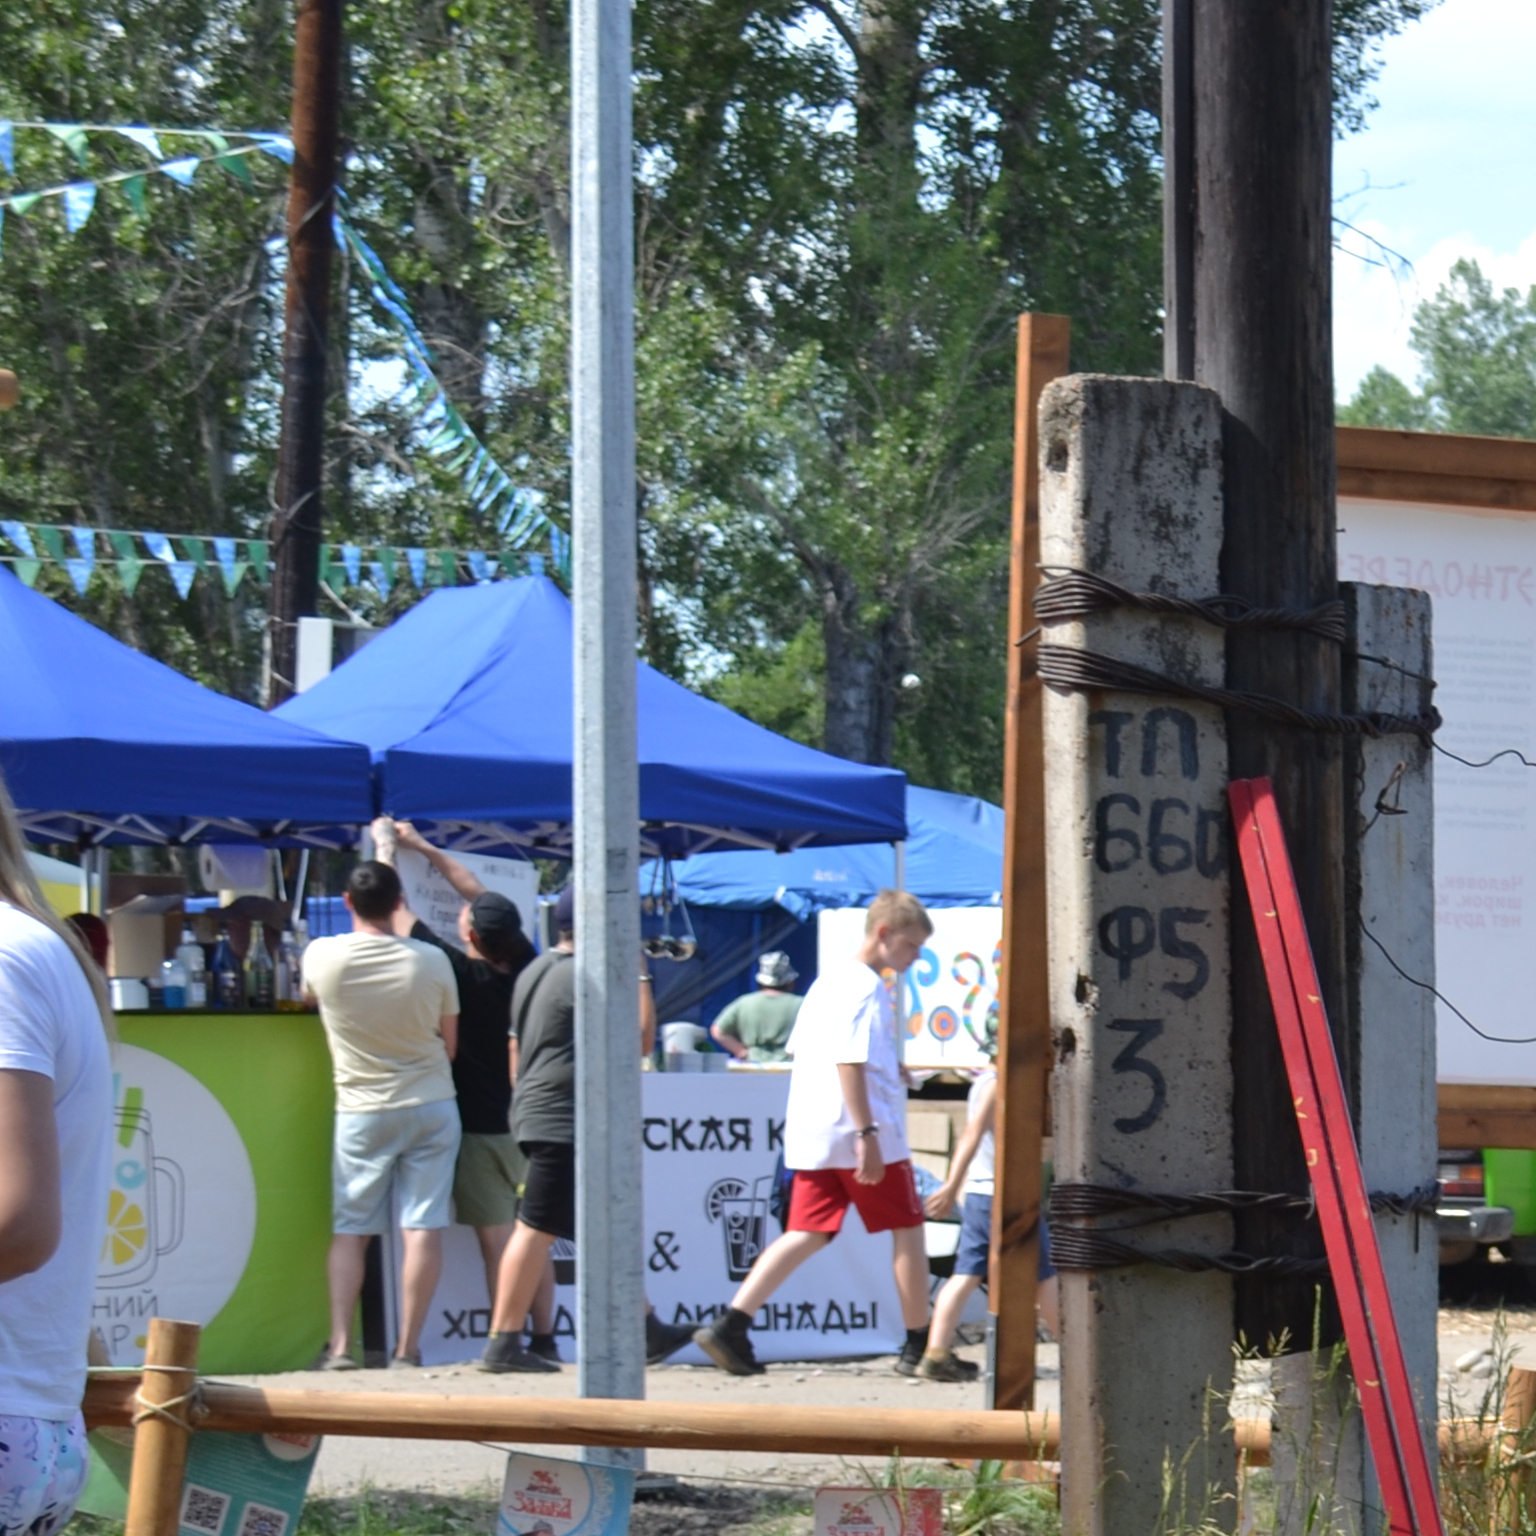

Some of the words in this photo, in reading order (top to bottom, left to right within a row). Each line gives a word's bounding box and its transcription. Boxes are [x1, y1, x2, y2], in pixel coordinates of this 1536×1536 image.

[1089, 706, 1198, 780] ТП
[1099, 905, 1209, 1000] Ф5
[1105, 1018, 1167, 1133] 3
[672, 1300, 878, 1336] ЛИОНАДЫ
